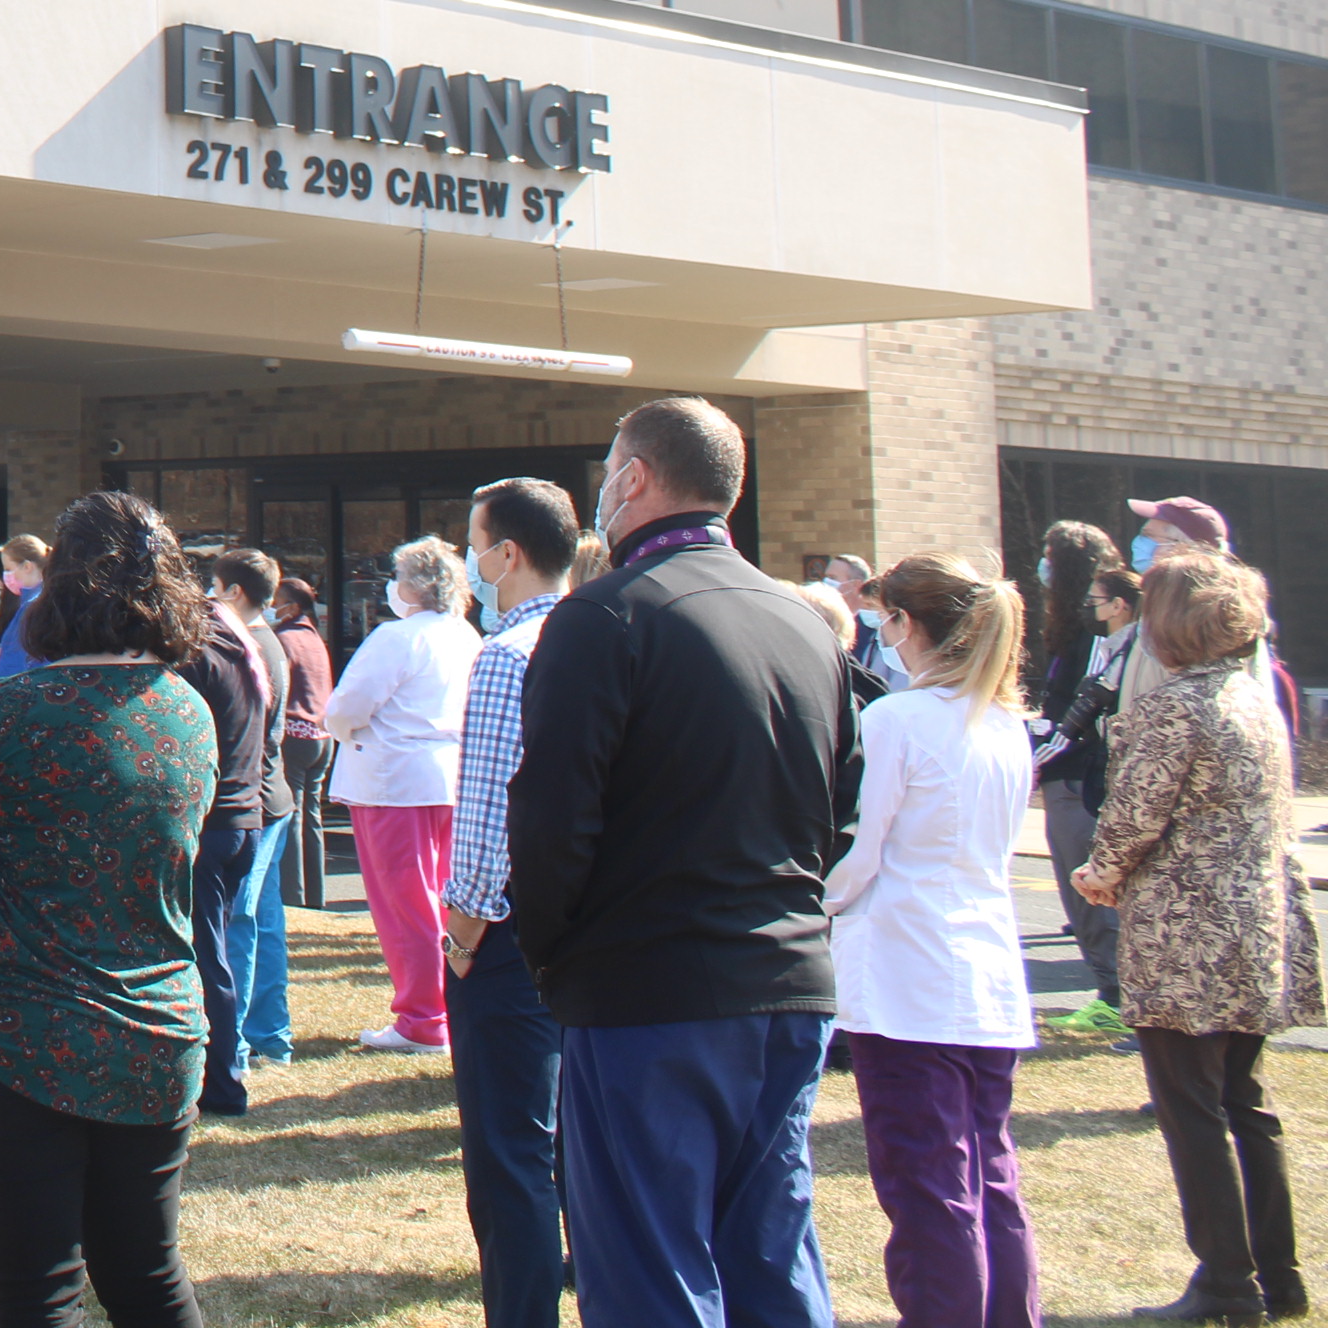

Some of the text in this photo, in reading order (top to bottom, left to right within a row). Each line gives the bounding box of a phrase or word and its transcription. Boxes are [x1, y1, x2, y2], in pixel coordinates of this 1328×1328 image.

[164, 23, 611, 174] ENTRANCE
[186, 139, 574, 228] 271 & 299 CAREW ST.
